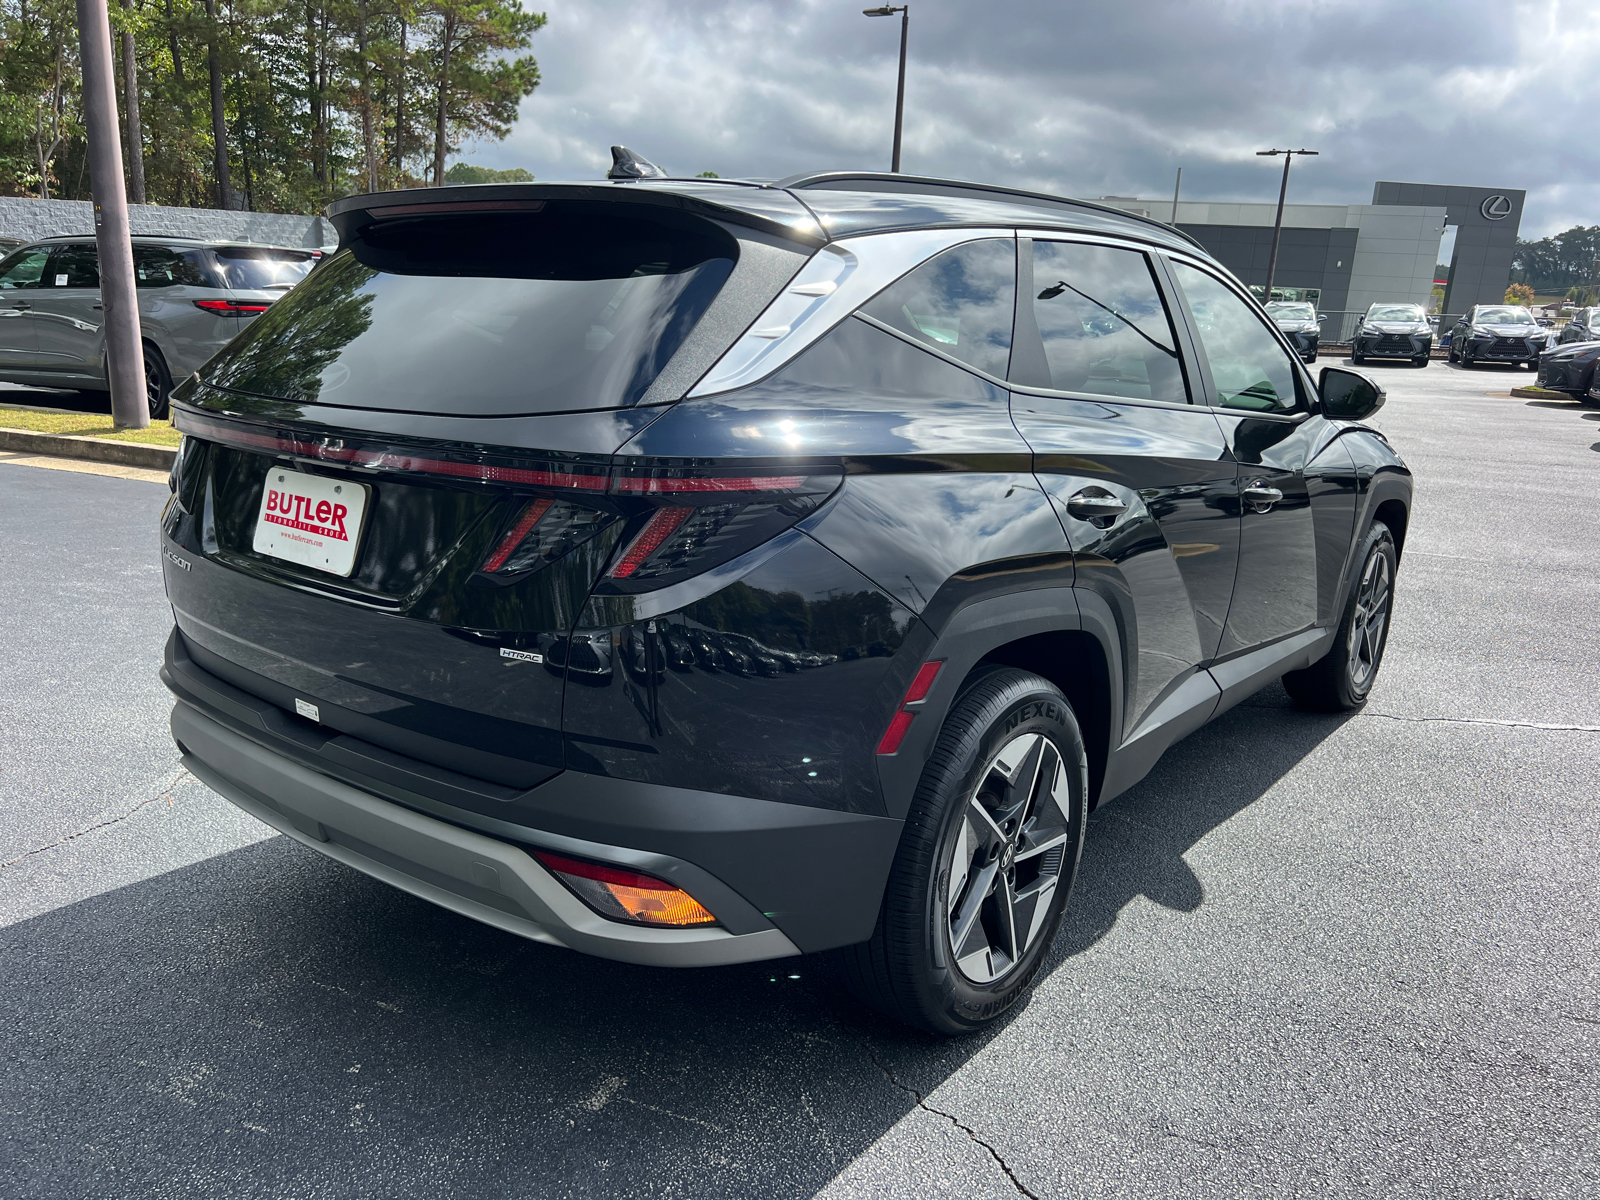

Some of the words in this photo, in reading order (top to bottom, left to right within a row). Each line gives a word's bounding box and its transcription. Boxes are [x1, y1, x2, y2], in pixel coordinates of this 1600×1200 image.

[264, 514, 312, 531] AUTOMOTIVE
[318, 527, 346, 540] GROUP
[280, 531, 324, 547] www.butlercars.com
[502, 649, 540, 662] HTRAC
[1005, 701, 1068, 736] NEXEN
